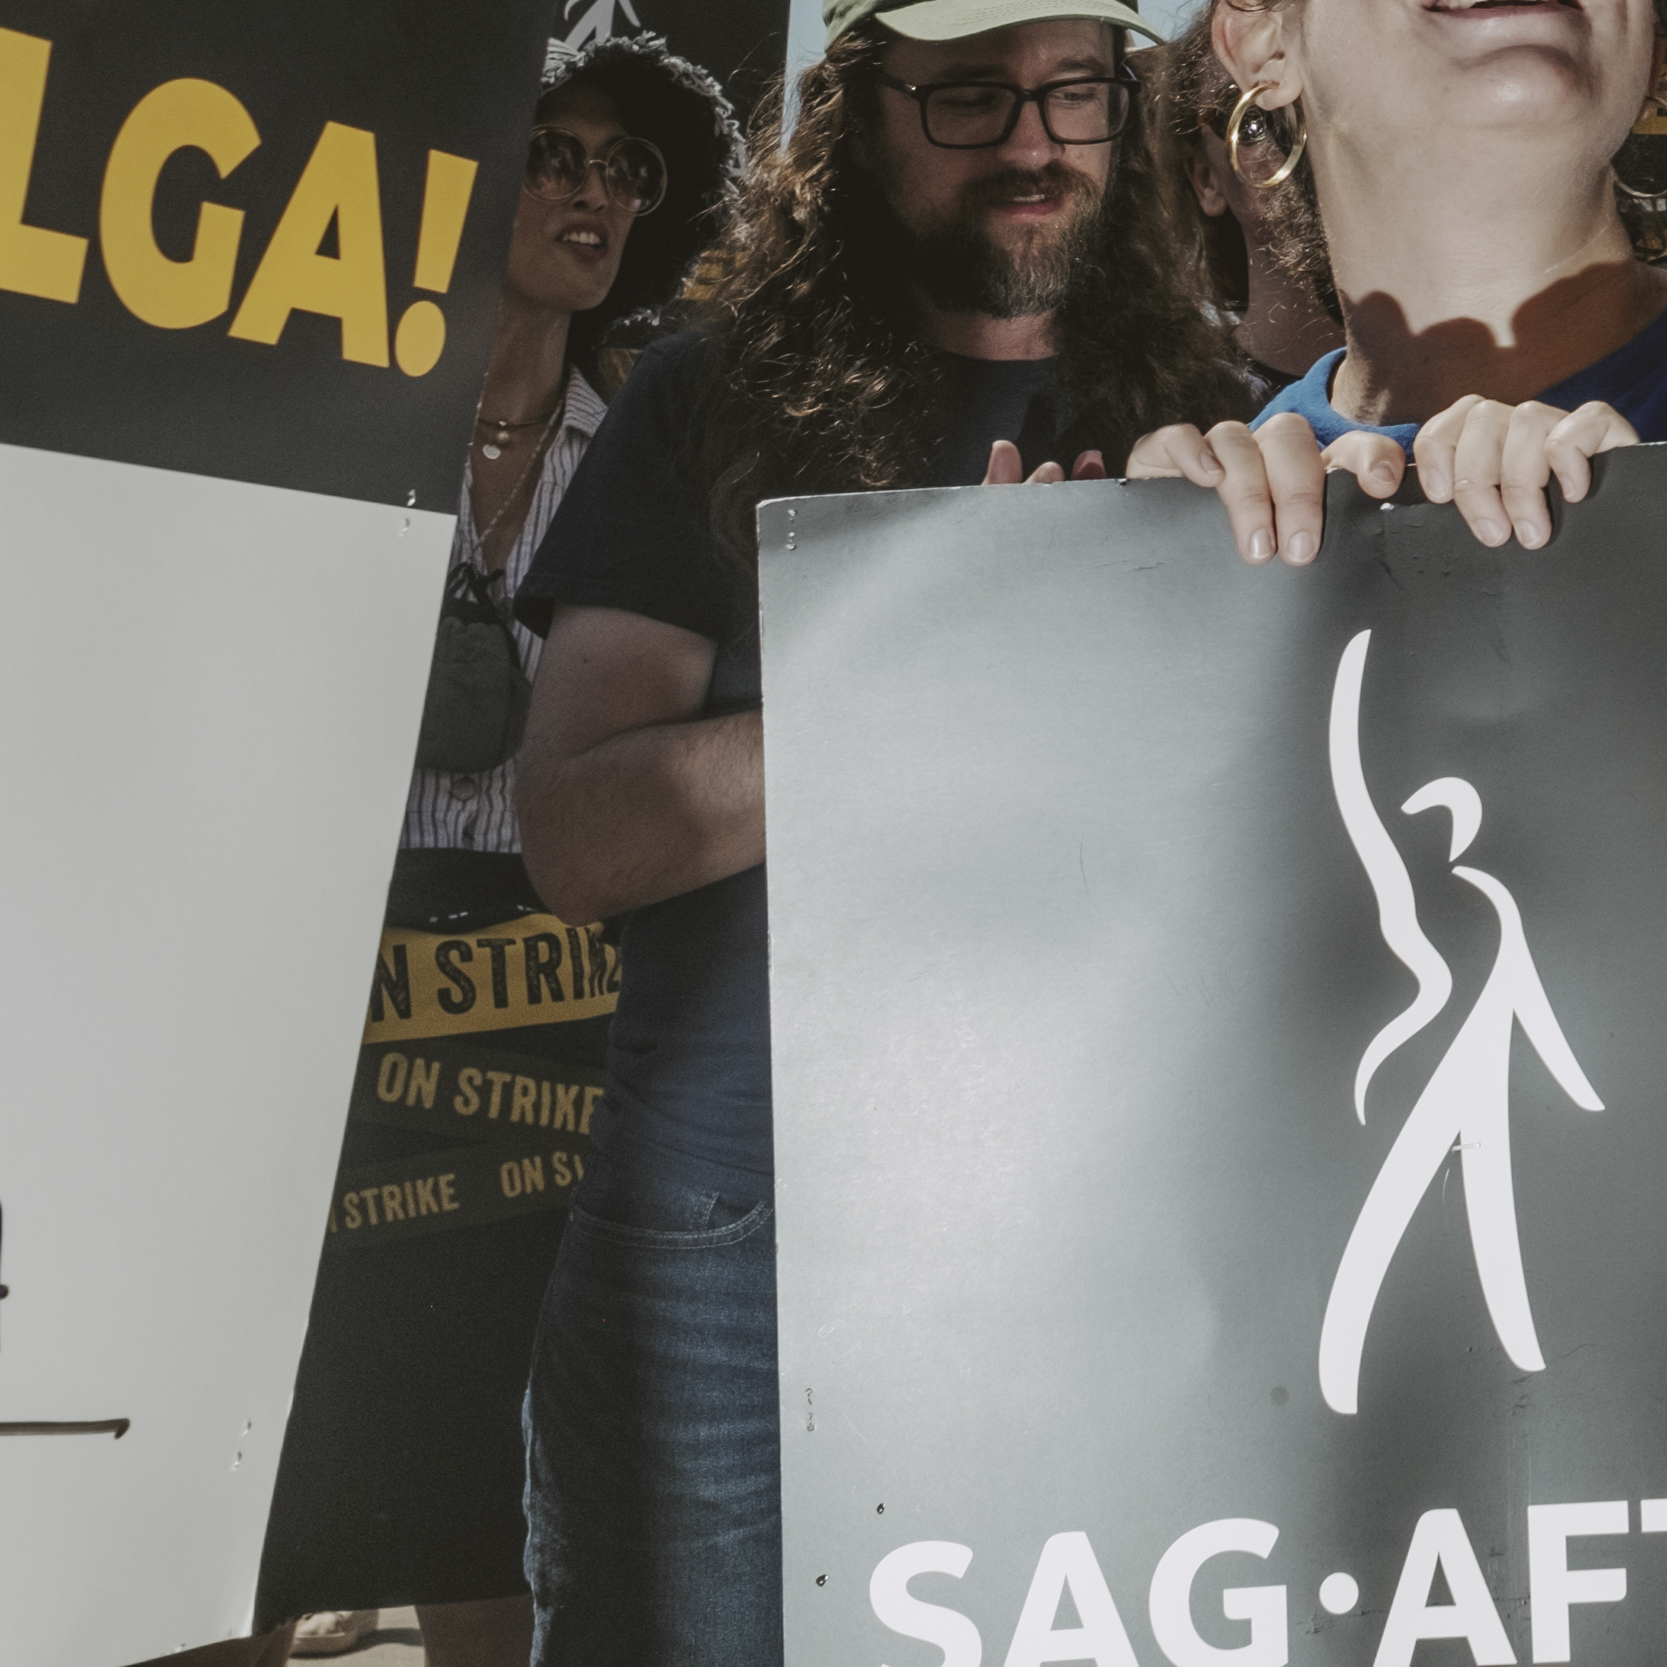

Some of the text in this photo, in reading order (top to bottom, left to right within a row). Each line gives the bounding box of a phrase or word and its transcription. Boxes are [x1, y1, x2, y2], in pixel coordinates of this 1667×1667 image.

[0, 26, 478, 377] LGA!
[376, 1051, 441, 1110] ON
[343, 1173, 461, 1230] STRIKE
[500, 1155, 546, 1198] ON
